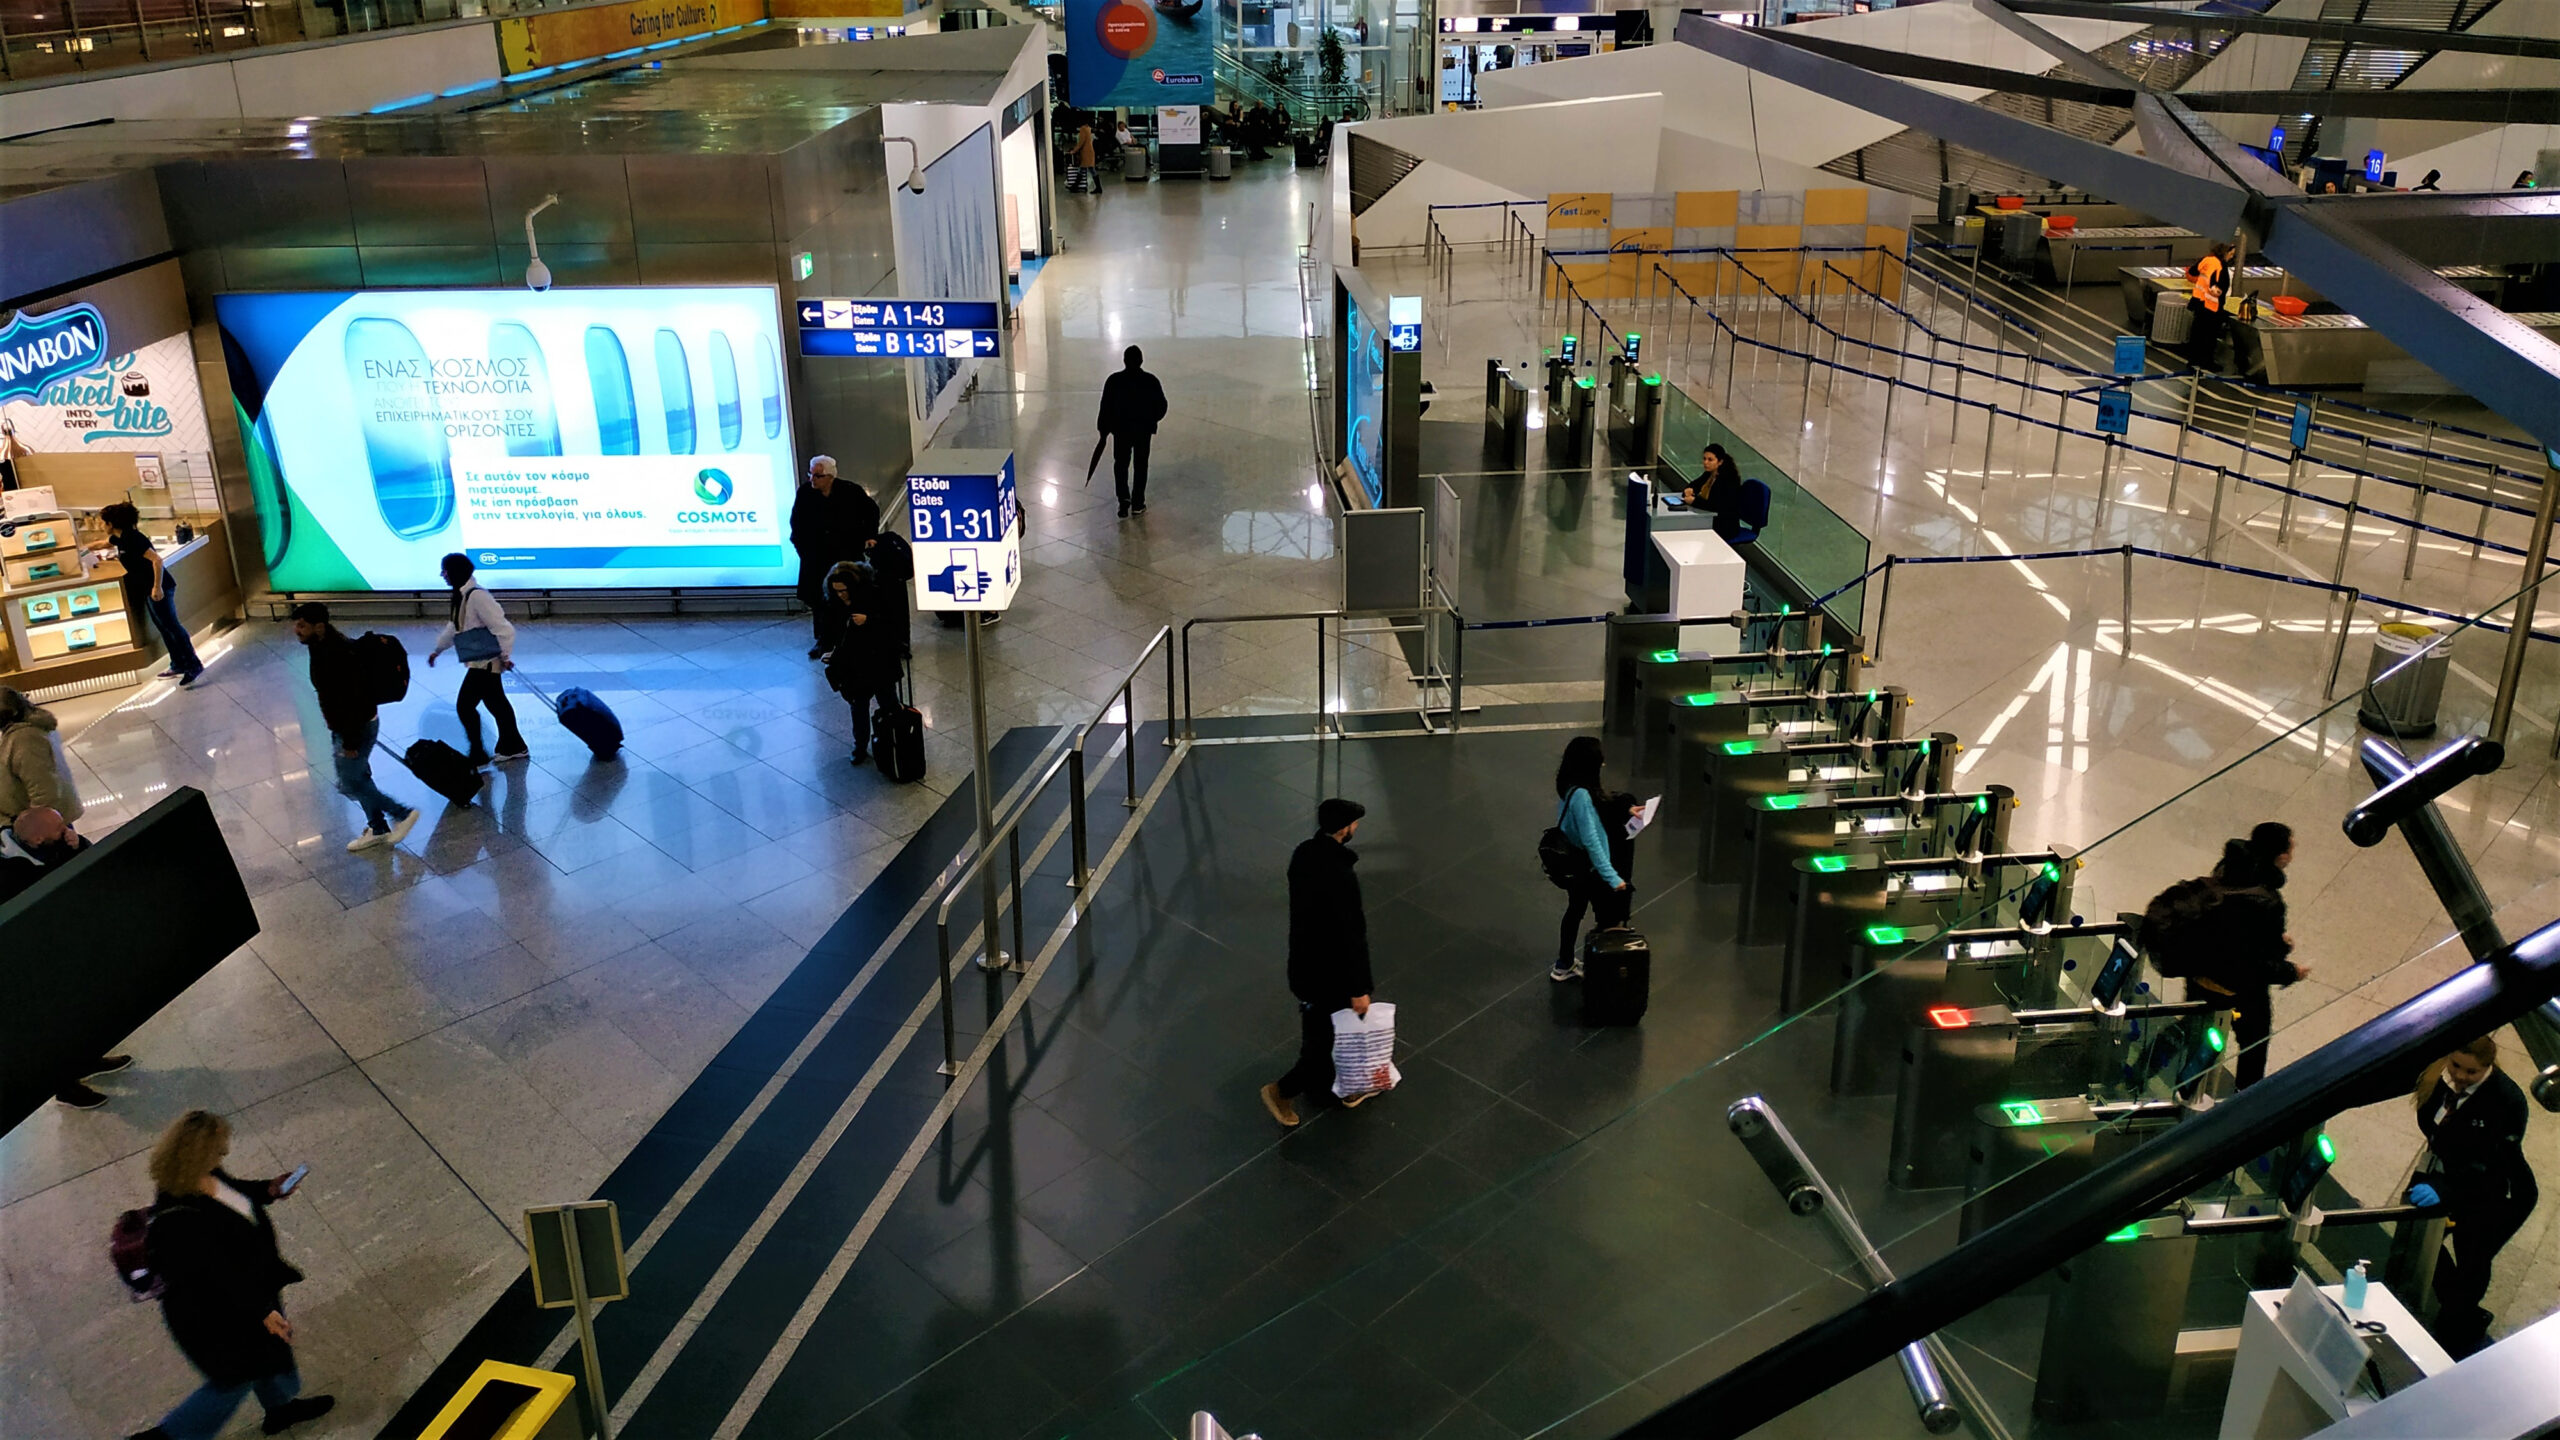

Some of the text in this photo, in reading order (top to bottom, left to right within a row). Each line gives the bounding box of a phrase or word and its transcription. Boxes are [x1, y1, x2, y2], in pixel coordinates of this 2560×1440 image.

[630, 4, 706, 37] Caring for Culture
[1165, 76, 1199, 84] Eurobank
[2272, 136, 2283, 150] 17
[2370, 159, 2381, 174] 16
[1559, 207, 1600, 216] Fast Lane
[882, 304, 944, 326] A 1-43
[885, 332, 944, 354] B 1-31
[364, 358, 531, 379] ΕΝΑΣ ΚΟΣΜΟΣ
[423, 379, 533, 394] ΤΕΧΝΟΛΟΓΙΑ
[64, 395, 173, 436] EVERY bite
[66, 409, 92, 418] INTO
[376, 409, 533, 423] ΕΠΙΧΕΙΡΗΜΑΤΙΚΟΥΣ ΣΟΥ
[443, 423, 536, 437] ΟΡΙΖΟΝΤΕΣ
[466, 469, 590, 482] Σε αυτόν τον κόσμο
[908, 477, 950, 492] Έξοδοι
[470, 496, 578, 509] Με ίση πρόσβαση
[912, 493, 944, 506] Gates
[473, 508, 647, 521] στην τεχνολογία, για όλους.
[677, 511, 758, 524] COSMOTE
[913, 508, 994, 539] B 1-31
